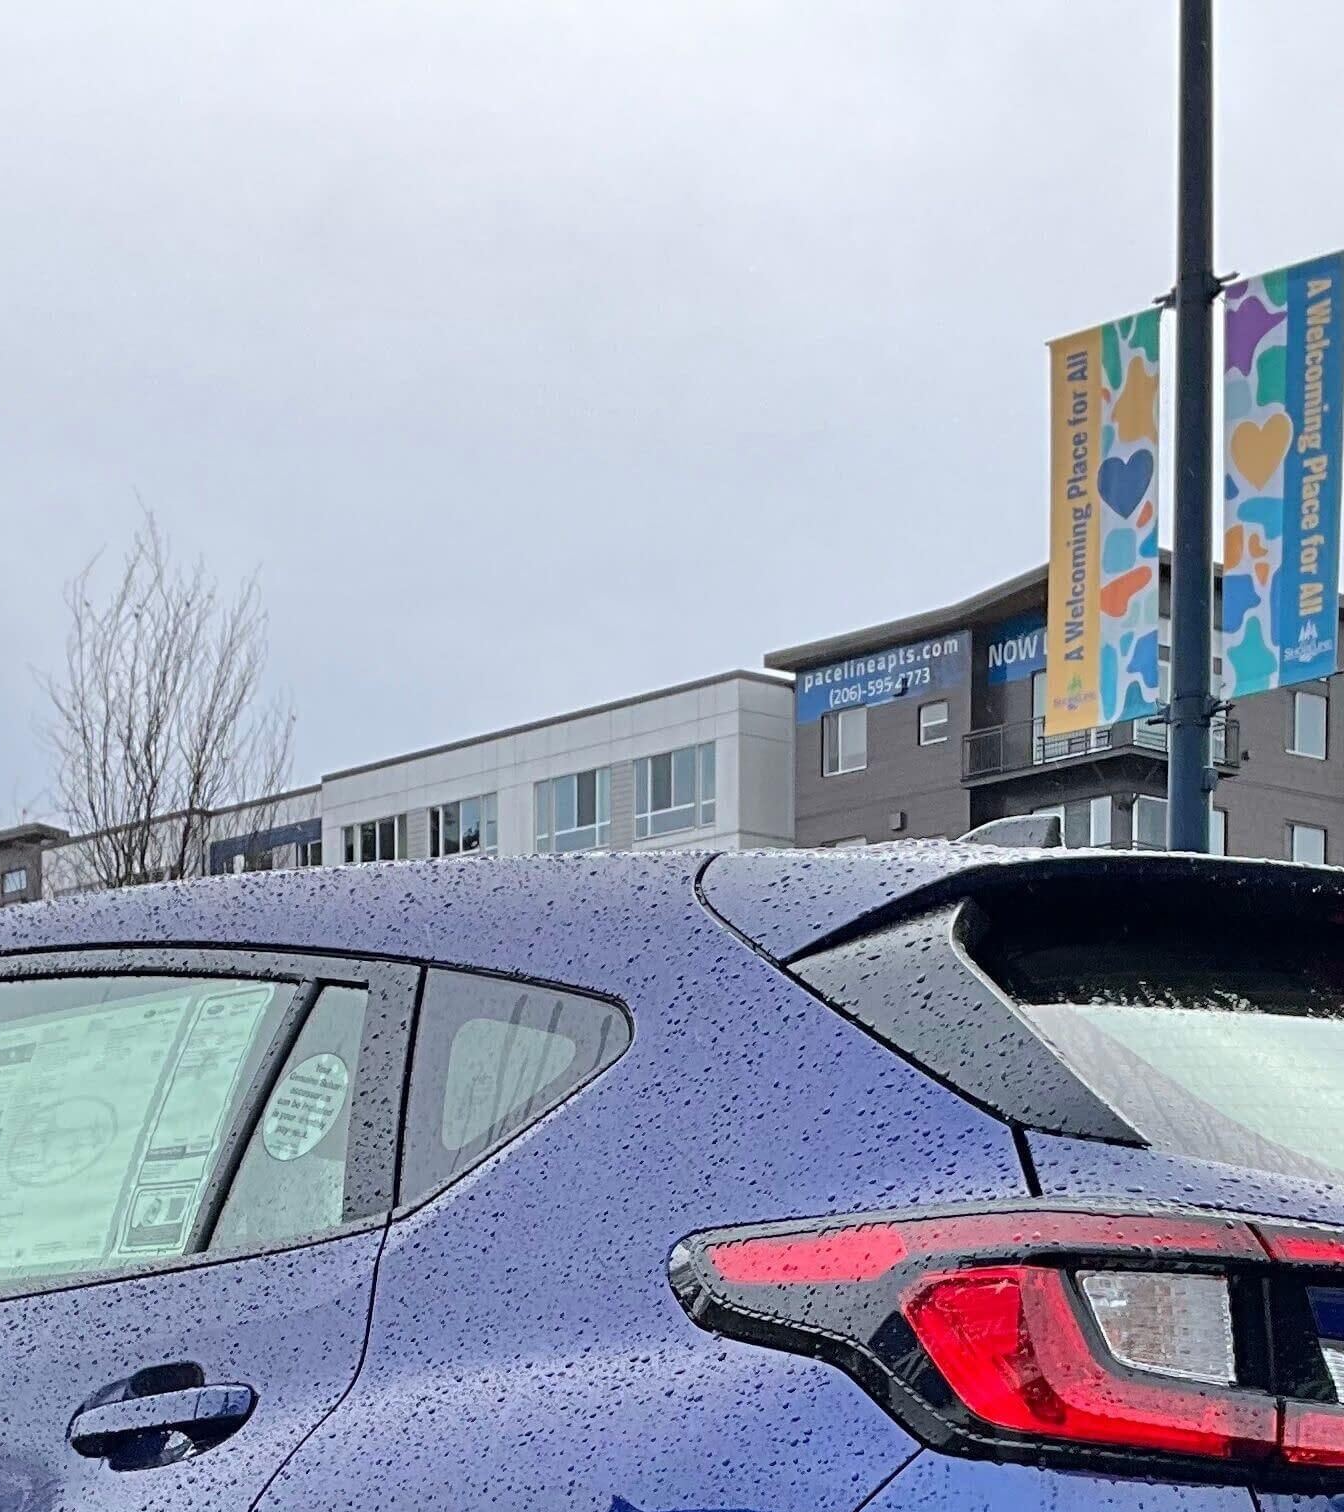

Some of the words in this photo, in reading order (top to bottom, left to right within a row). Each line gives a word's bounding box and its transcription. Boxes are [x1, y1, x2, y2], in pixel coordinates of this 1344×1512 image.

[1307, 278, 1332, 299] A
[1066, 350, 1088, 382] All
[1298, 297, 1332, 454] Welcoming
[1067, 391, 1088, 426] for
[1067, 432, 1088, 500] Place
[1301, 454, 1329, 531] Place
[1064, 503, 1093, 643] Welcoming
[1299, 534, 1325, 575] for
[1298, 582, 1324, 617] All
[804, 637, 959, 693] pacelineapts.com
[988, 633, 1038, 669] NOW
[1064, 645, 1085, 662] A
